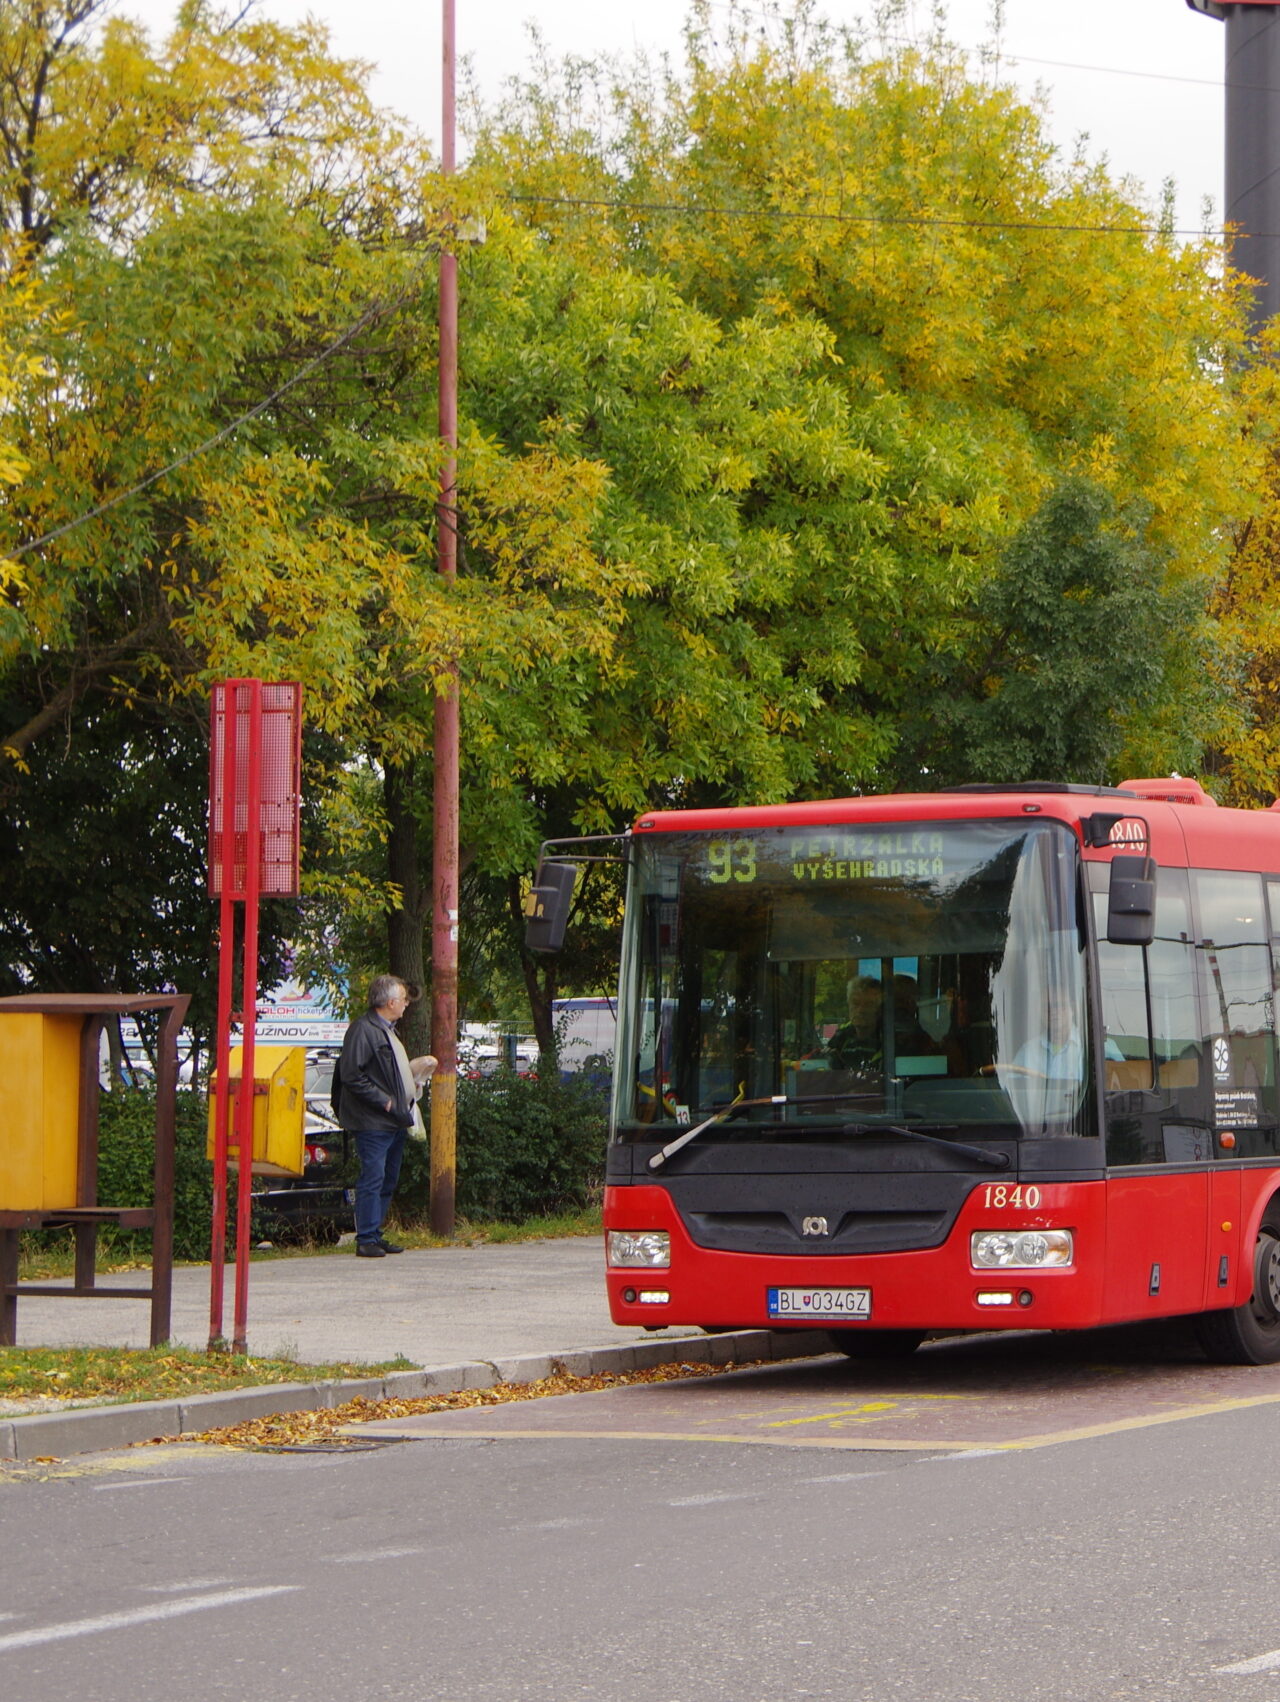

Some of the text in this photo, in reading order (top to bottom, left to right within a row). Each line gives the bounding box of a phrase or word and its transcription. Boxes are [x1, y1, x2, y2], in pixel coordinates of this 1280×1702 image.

[1110, 821, 1145, 851] 1840
[708, 840, 757, 884] 93
[792, 854, 944, 881] VYŠEHRADSKÁ
[255, 1025, 308, 1036] UŽINOV
[984, 1185, 1040, 1208] 1840
[780, 1292, 801, 1311] BL
[812, 1292, 866, 1311] 034GZ
